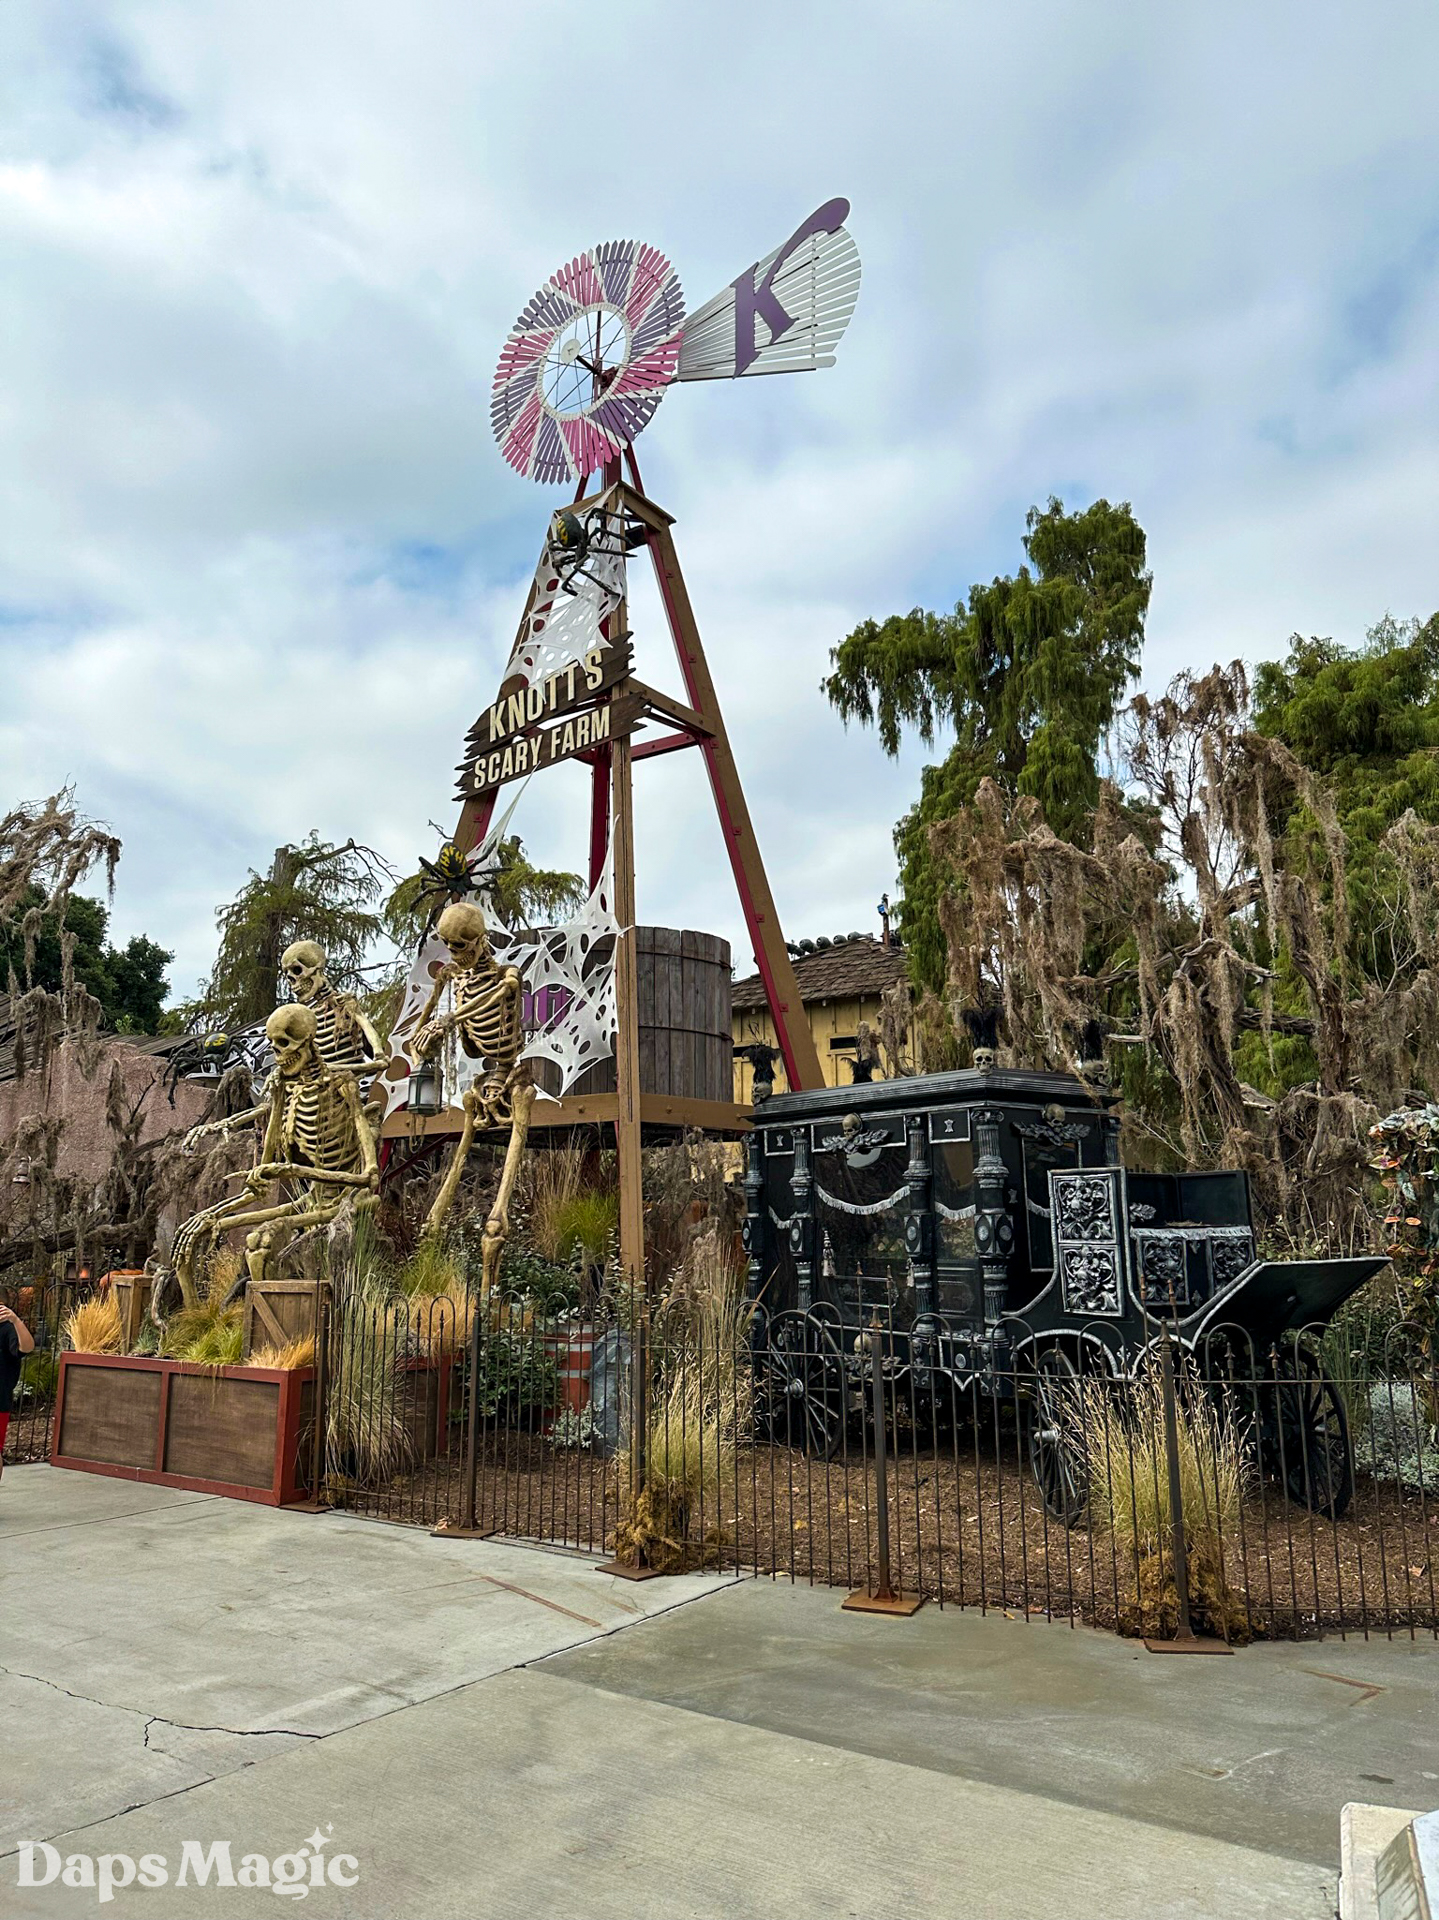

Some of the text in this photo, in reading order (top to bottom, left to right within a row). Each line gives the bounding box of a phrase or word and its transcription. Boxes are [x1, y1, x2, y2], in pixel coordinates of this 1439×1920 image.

[730, 197, 850, 379] K
[489, 649, 604, 743] KNOTTS
[473, 705, 611, 789] SCARY FARM
